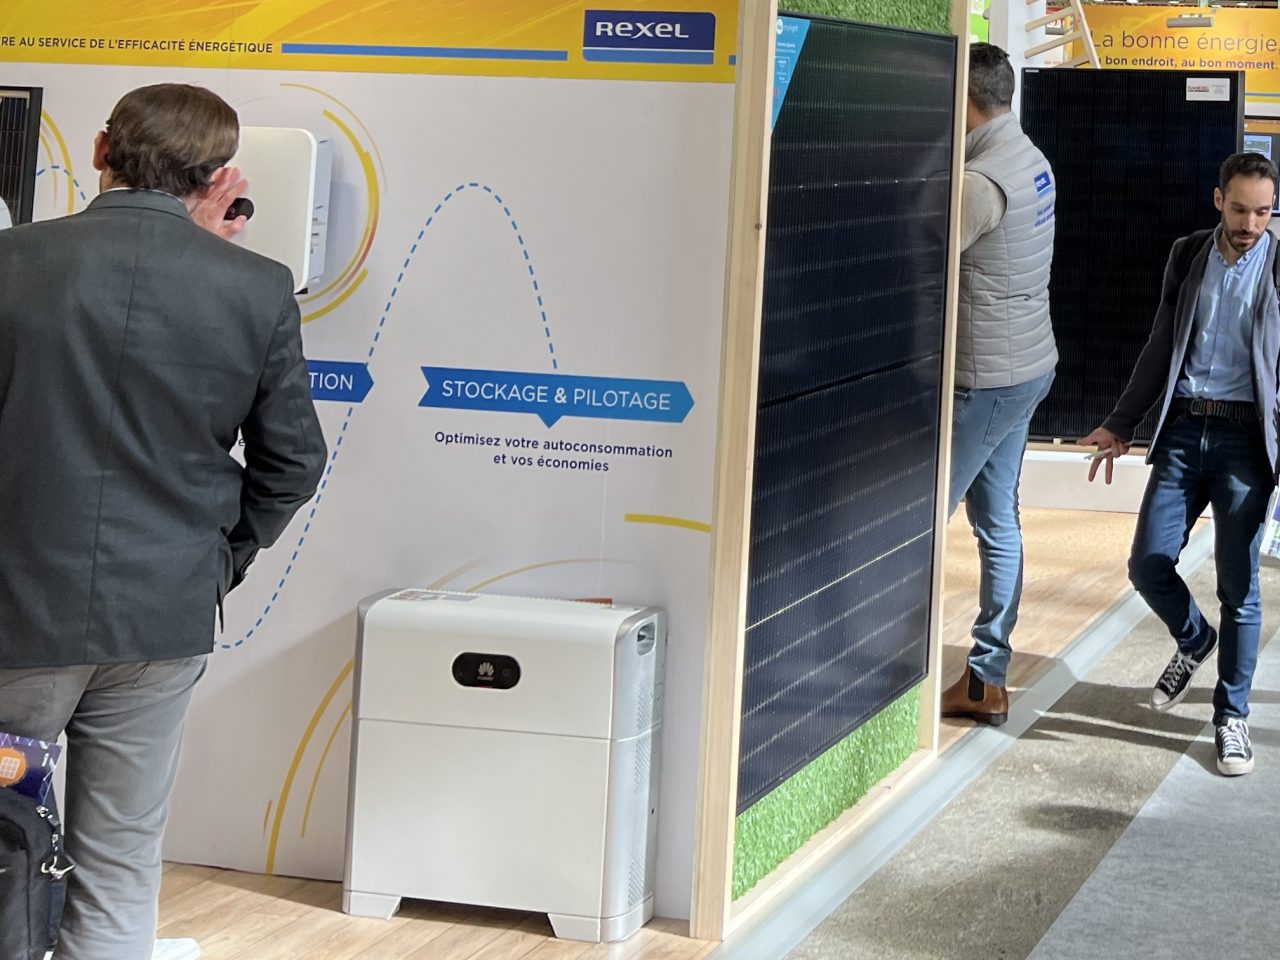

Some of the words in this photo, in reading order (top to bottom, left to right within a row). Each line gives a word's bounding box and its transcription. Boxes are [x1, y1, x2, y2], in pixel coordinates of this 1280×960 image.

[19, 37, 35, 48] AU
[38, 37, 86, 49] SERVICE
[90, 39, 105, 49] DE
[108, 39, 186, 52] L'EFFICACITÉ
[189, 39, 274, 54] ÉNERGÉTIQUE
[1091, 32, 1114, 49] La
[1122, 30, 1189, 50] bonne
[1105, 55, 1128, 66] bon
[1131, 55, 1178, 68] endroit,
[1181, 59, 1195, 68] au
[1199, 58, 1222, 69] bon
[1225, 60, 1279, 71] moment.
[307, 372, 354, 391] TION
[441, 379, 549, 403] STOCKAGE
[553, 388, 567, 404] &
[573, 388, 672, 411] PILOTAGE
[434, 431, 501, 447] Optimisez
[505, 435, 539, 450] votre
[543, 441, 673, 459] autoconsommation
[493, 453, 507, 465] et
[510, 455, 534, 467] vos
[537, 455, 610, 472] économies
